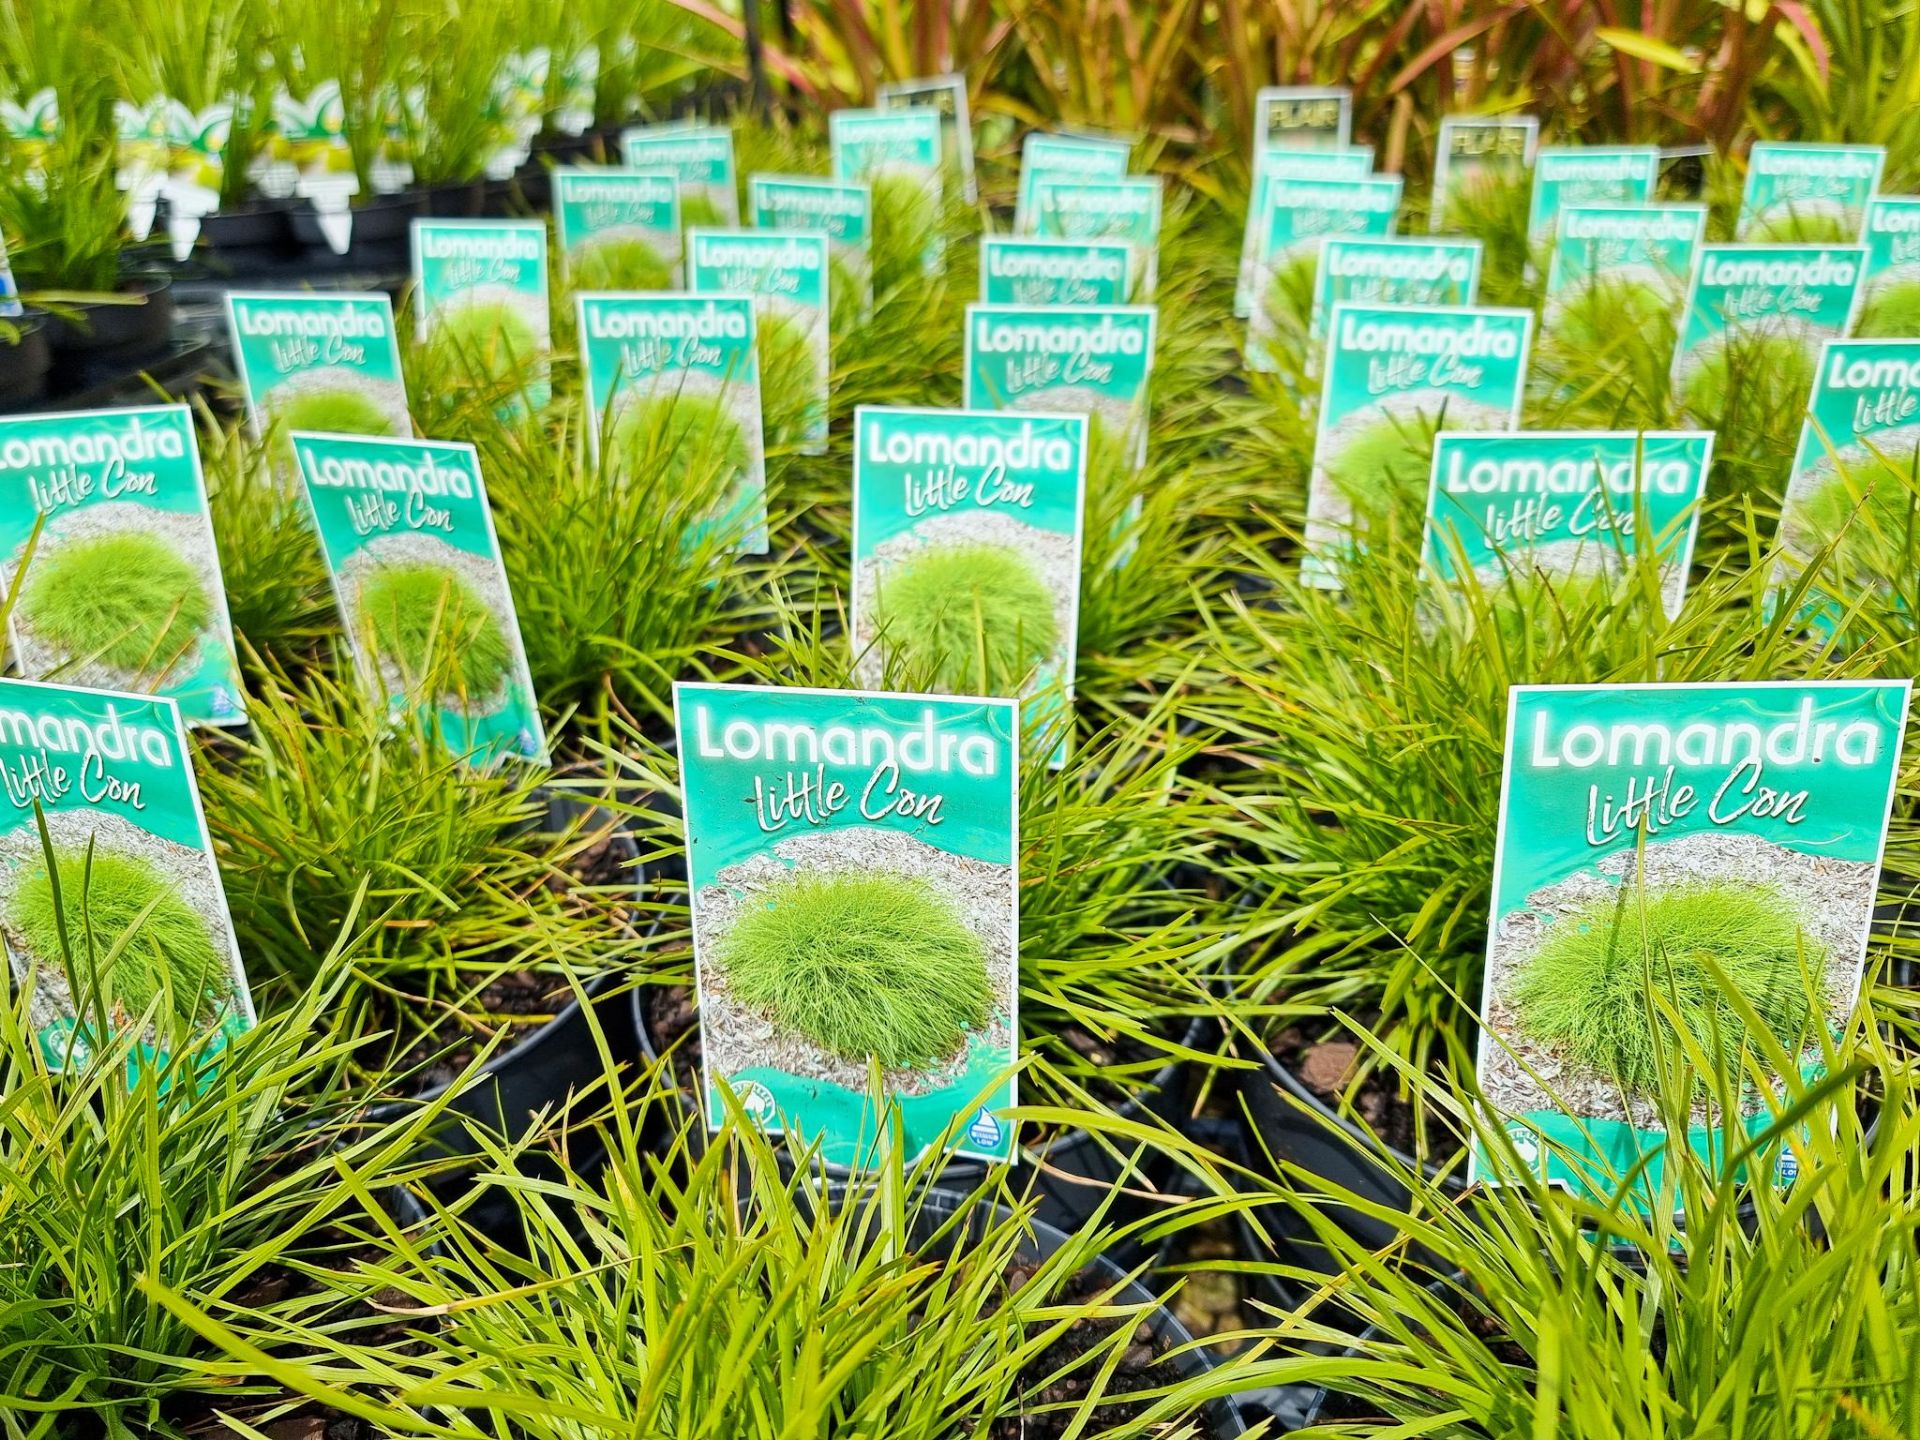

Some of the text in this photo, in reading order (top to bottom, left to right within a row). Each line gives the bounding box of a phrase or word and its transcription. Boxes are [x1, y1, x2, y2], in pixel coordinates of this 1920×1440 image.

[422, 228, 539, 260] Lomandra
[698, 237, 820, 269] Lomandra
[989, 245, 1122, 281] Lomandra
[1702, 252, 1855, 287] Lomandra
[239, 301, 386, 337] Lomandra
[589, 301, 747, 339] Lomandra
[978, 313, 1144, 355] Lomandra
[1340, 313, 1518, 359] Lomandra
[271, 332, 367, 375] Little Con
[619, 335, 723, 378] Little Con
[1006, 349, 1114, 394] Little Con
[1367, 350, 1484, 395] Little Con
[1852, 384, 1919, 434] Little
[868, 420, 1073, 472] Lomandra
[27, 453, 159, 516] Little Con
[302, 446, 473, 500] Lomandra
[903, 461, 1034, 518] Little Con
[344, 488, 455, 537] Little Con
[1483, 490, 1564, 550] Little
[0, 703, 173, 767] mandra
[695, 705, 998, 776] Lomandra
[1532, 697, 1880, 770] Lomandra
[0, 747, 146, 811] Little Con
[752, 759, 945, 832] Little Con
[1585, 757, 1812, 847] Little Con
